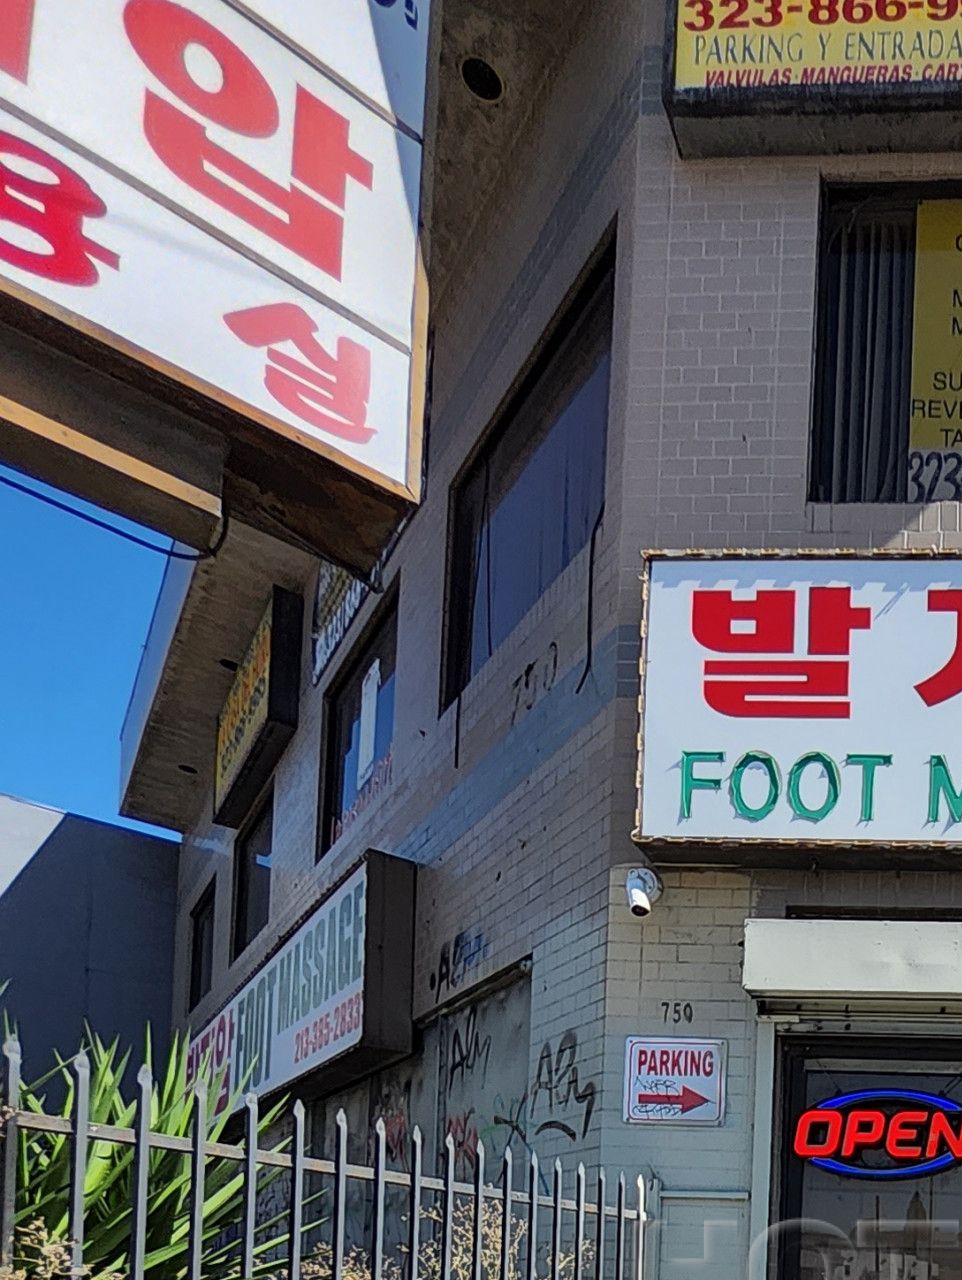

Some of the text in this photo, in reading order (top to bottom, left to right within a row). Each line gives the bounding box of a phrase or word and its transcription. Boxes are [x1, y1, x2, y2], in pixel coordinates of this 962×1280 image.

[693, 31, 803, 66] PARKING
[818, 31, 832, 61] Y
[680, 750, 893, 824] FOOT
[233, 965, 277, 1096] FOOT
[276, 880, 365, 1036] MASSAGE
[637, 1049, 714, 1077] PARKING
